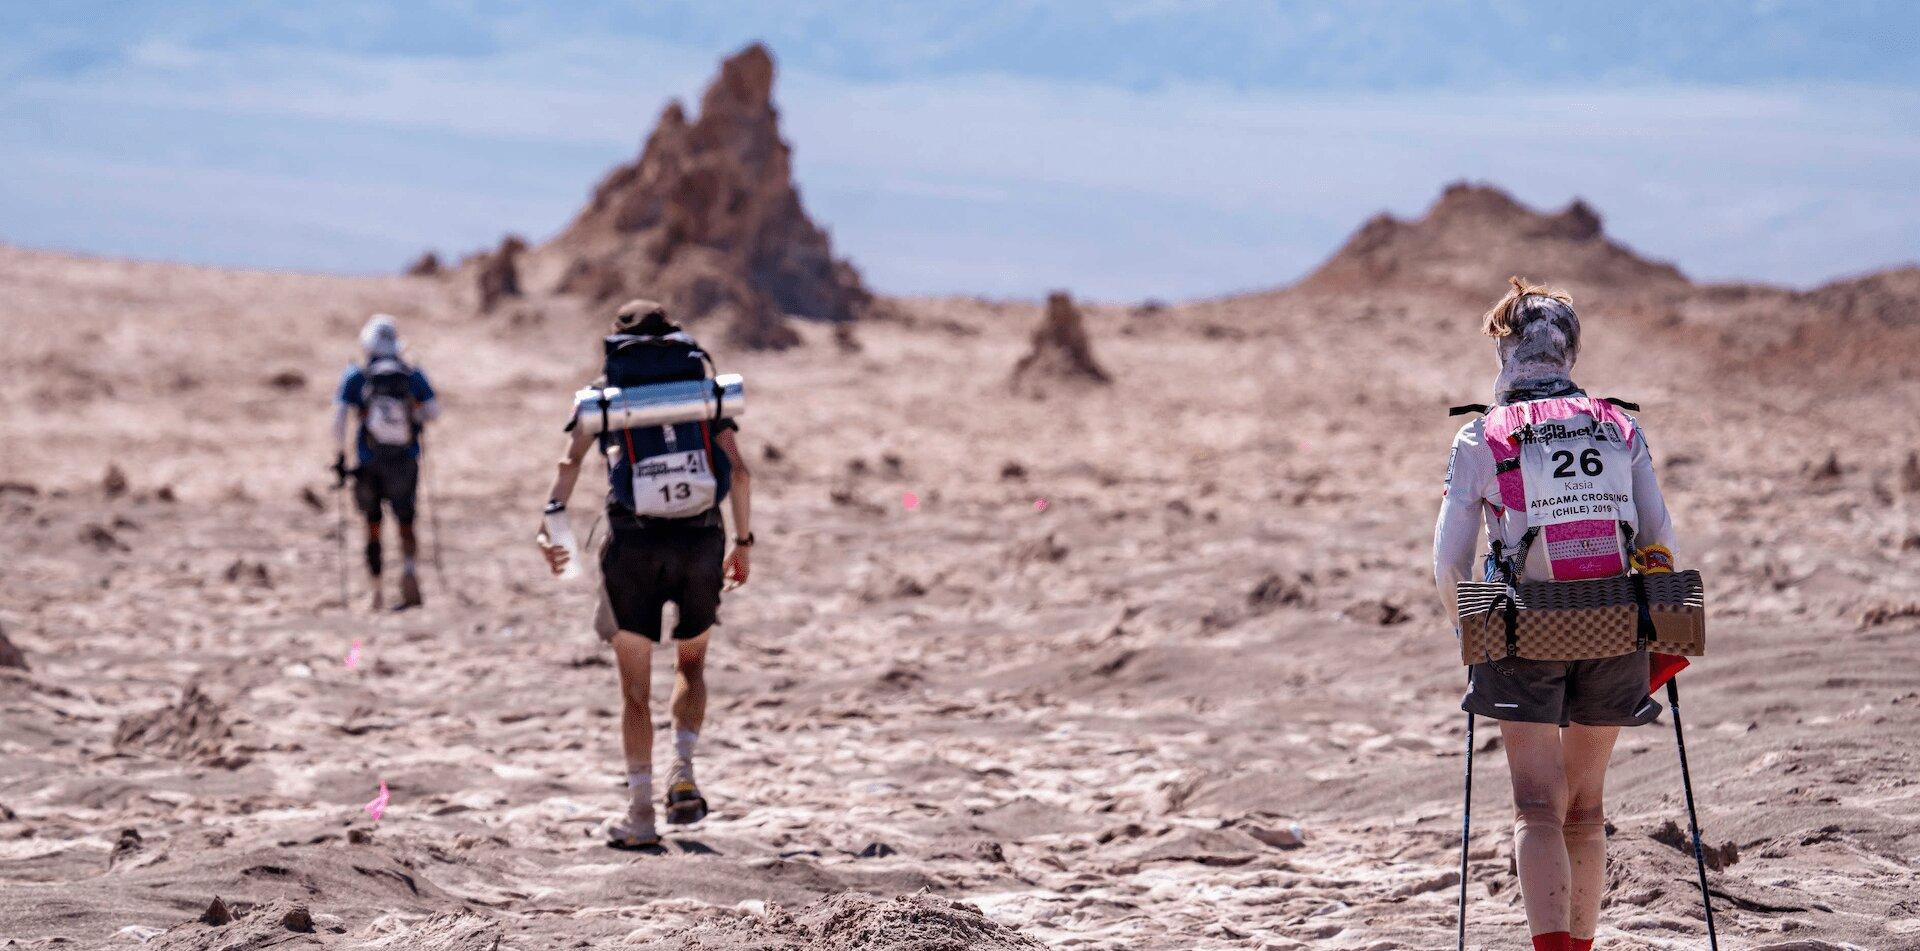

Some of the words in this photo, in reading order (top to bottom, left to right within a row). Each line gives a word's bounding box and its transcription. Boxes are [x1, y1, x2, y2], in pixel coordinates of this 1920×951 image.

[1551, 448, 1604, 479] 26
[659, 482, 691, 502] 13
[1564, 481, 1594, 491] Kasia
[1531, 494, 1579, 509] ATACAMA
[1581, 493, 1629, 503] CROSSING
[1552, 505, 1590, 519] (CHILE)
[1592, 504, 1612, 513] 2019
